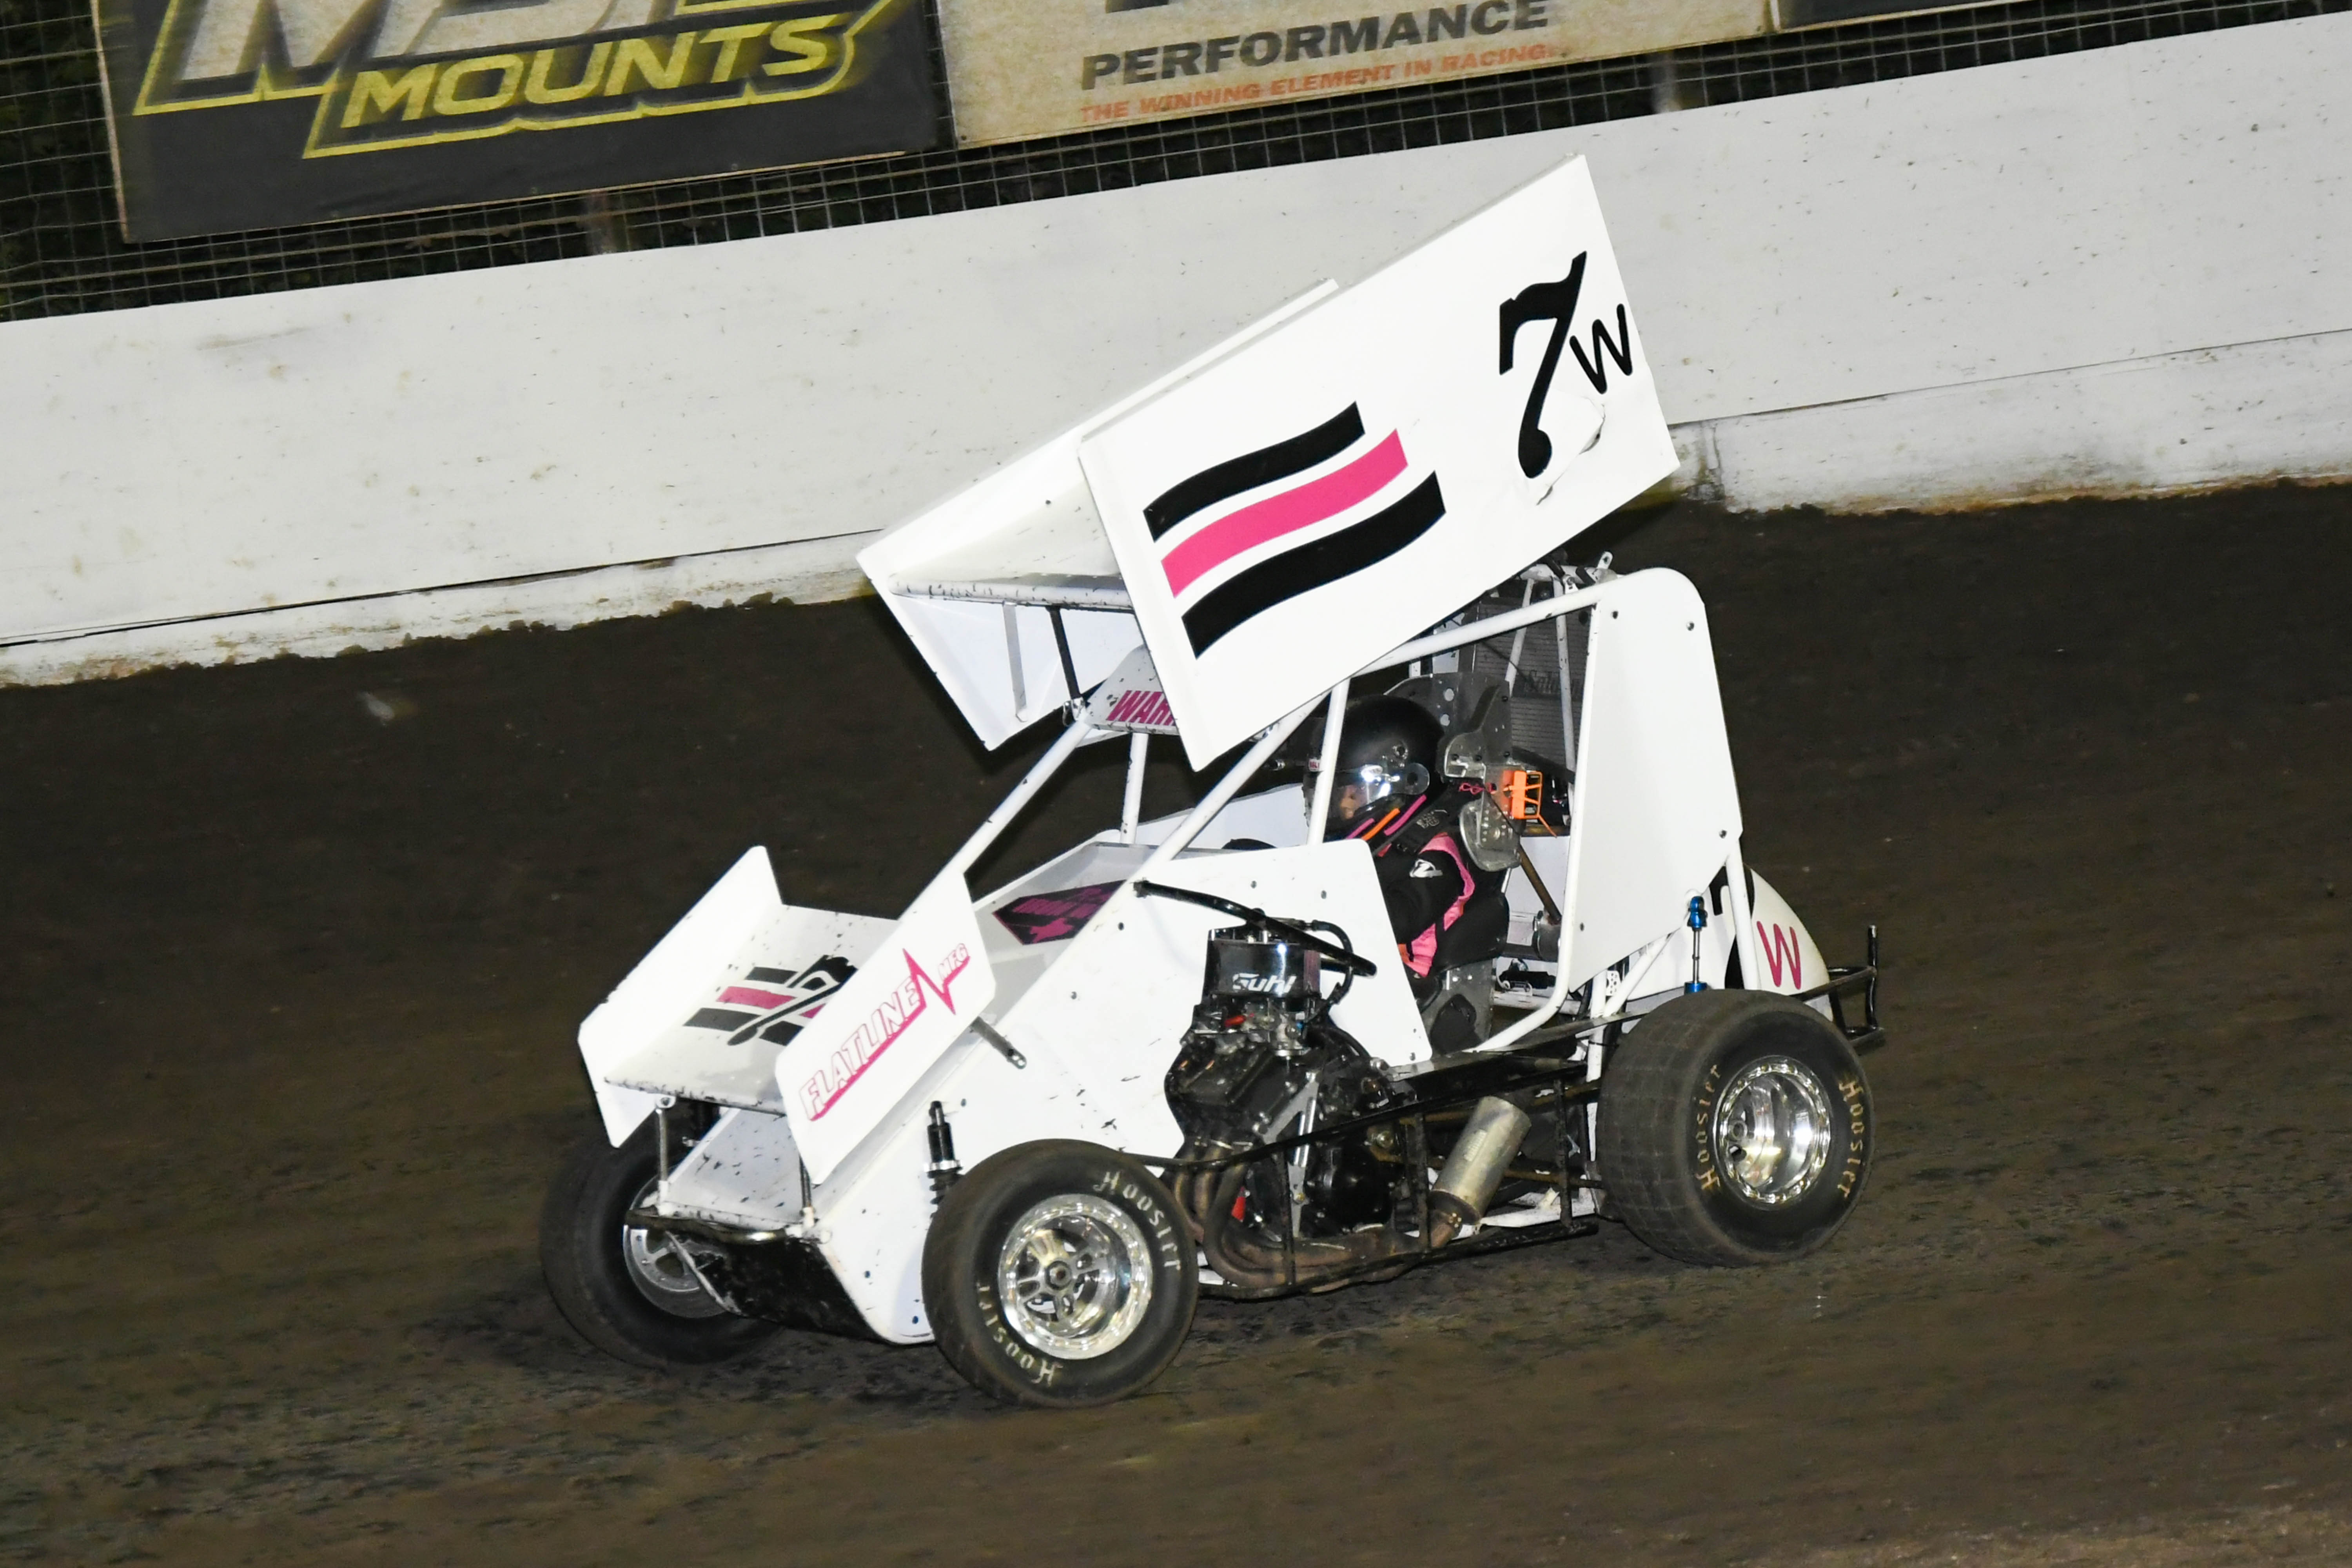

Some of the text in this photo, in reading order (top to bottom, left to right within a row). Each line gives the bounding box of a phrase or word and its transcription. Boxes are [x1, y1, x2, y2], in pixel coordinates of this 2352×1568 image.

[340, 14, 837, 129] MOUNTS
[1081, 101, 1129, 122] THE
[1140, 83, 1261, 114] WINNING
[1270, 64, 1396, 96] ELEMENT
[1404, 60, 1432, 77] IN
[1082, 0, 1548, 90] PERFORMANCE
[799, 943, 970, 1121] FLATLINE MFG
